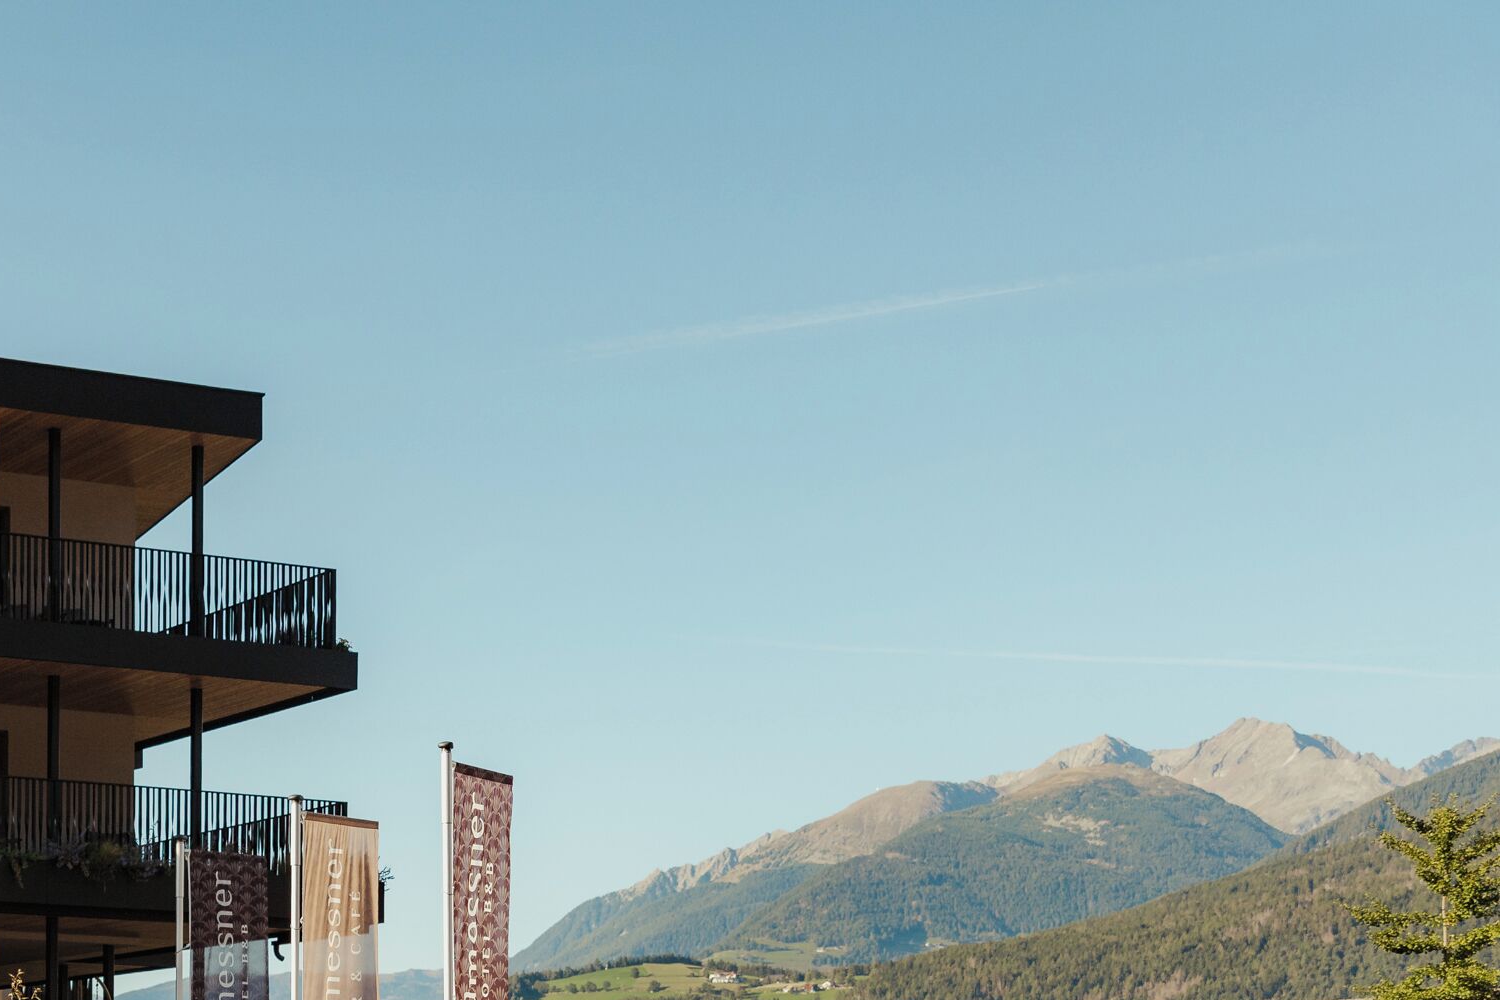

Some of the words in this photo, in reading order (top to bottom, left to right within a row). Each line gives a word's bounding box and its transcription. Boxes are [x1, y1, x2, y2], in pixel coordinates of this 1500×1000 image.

[484, 862, 494, 913] B&B
[240, 924, 249, 963] B&B
[348, 890, 361, 955] CAFÉ
[350, 971, 362, 982] &
